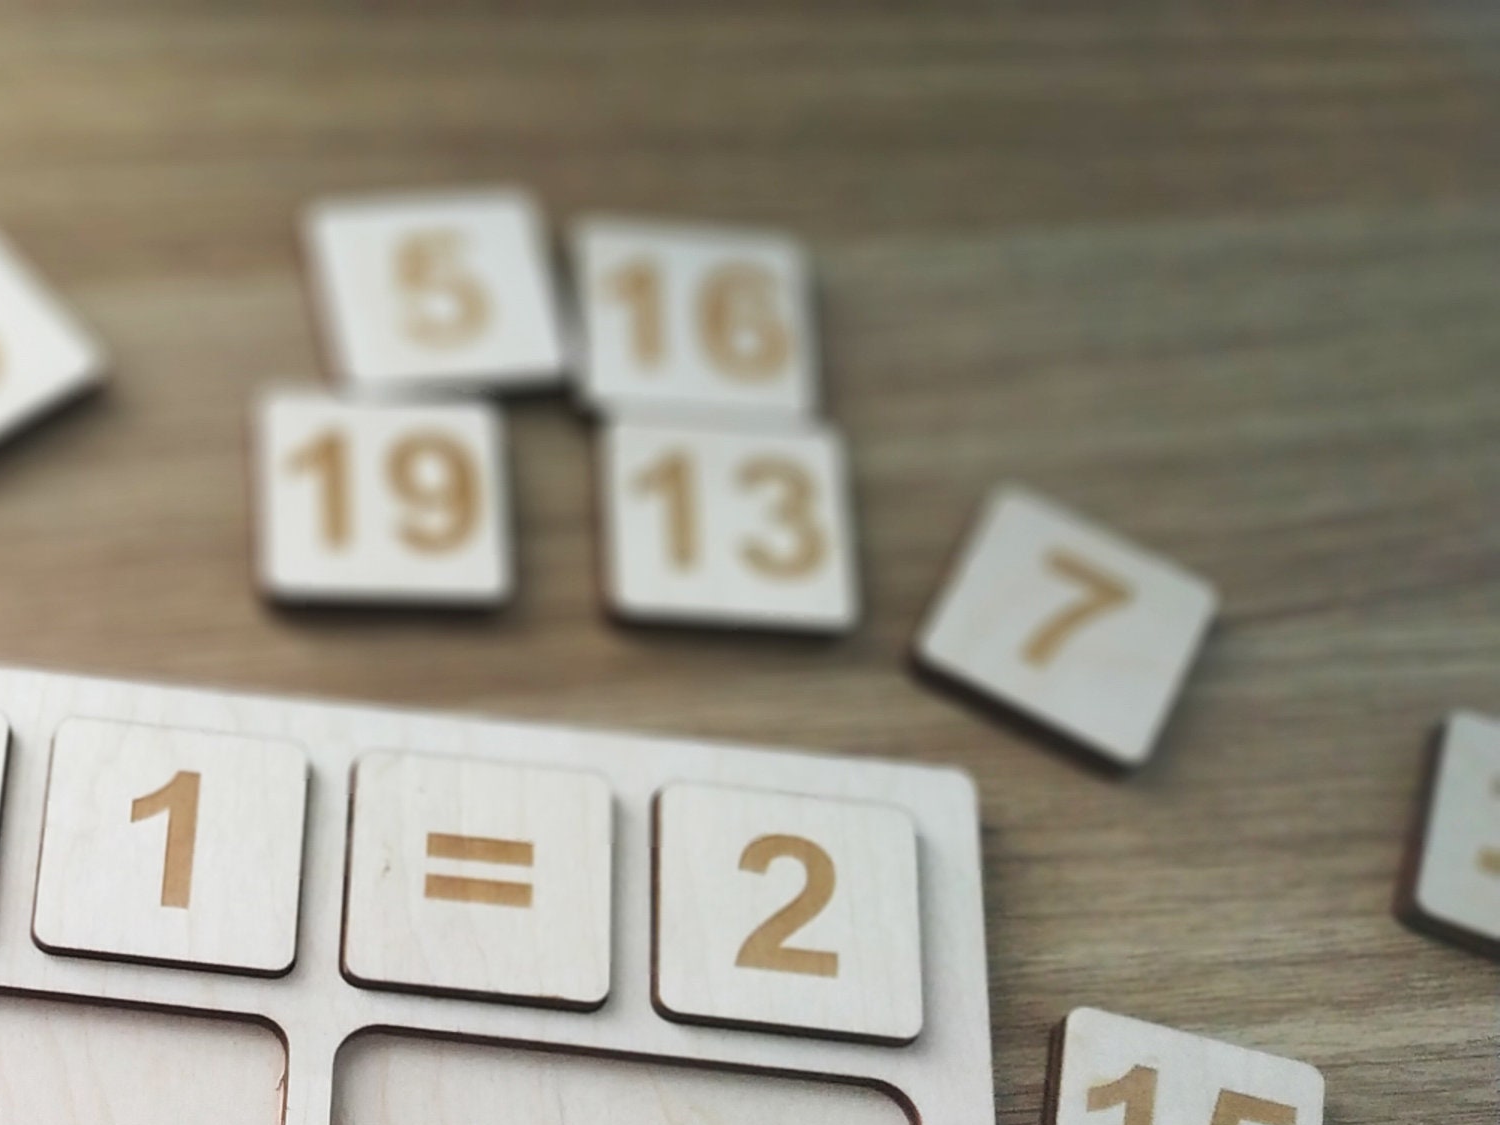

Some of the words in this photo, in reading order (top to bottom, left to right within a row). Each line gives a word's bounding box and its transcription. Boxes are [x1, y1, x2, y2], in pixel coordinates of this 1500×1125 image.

[390, 228, 492, 349] 5
[602, 256, 796, 385] 16
[289, 428, 486, 558] 19
[633, 447, 832, 583] 13
[1020, 546, 1136, 672] 7
[130, 770, 201, 908] 1
[736, 833, 839, 977] 2
